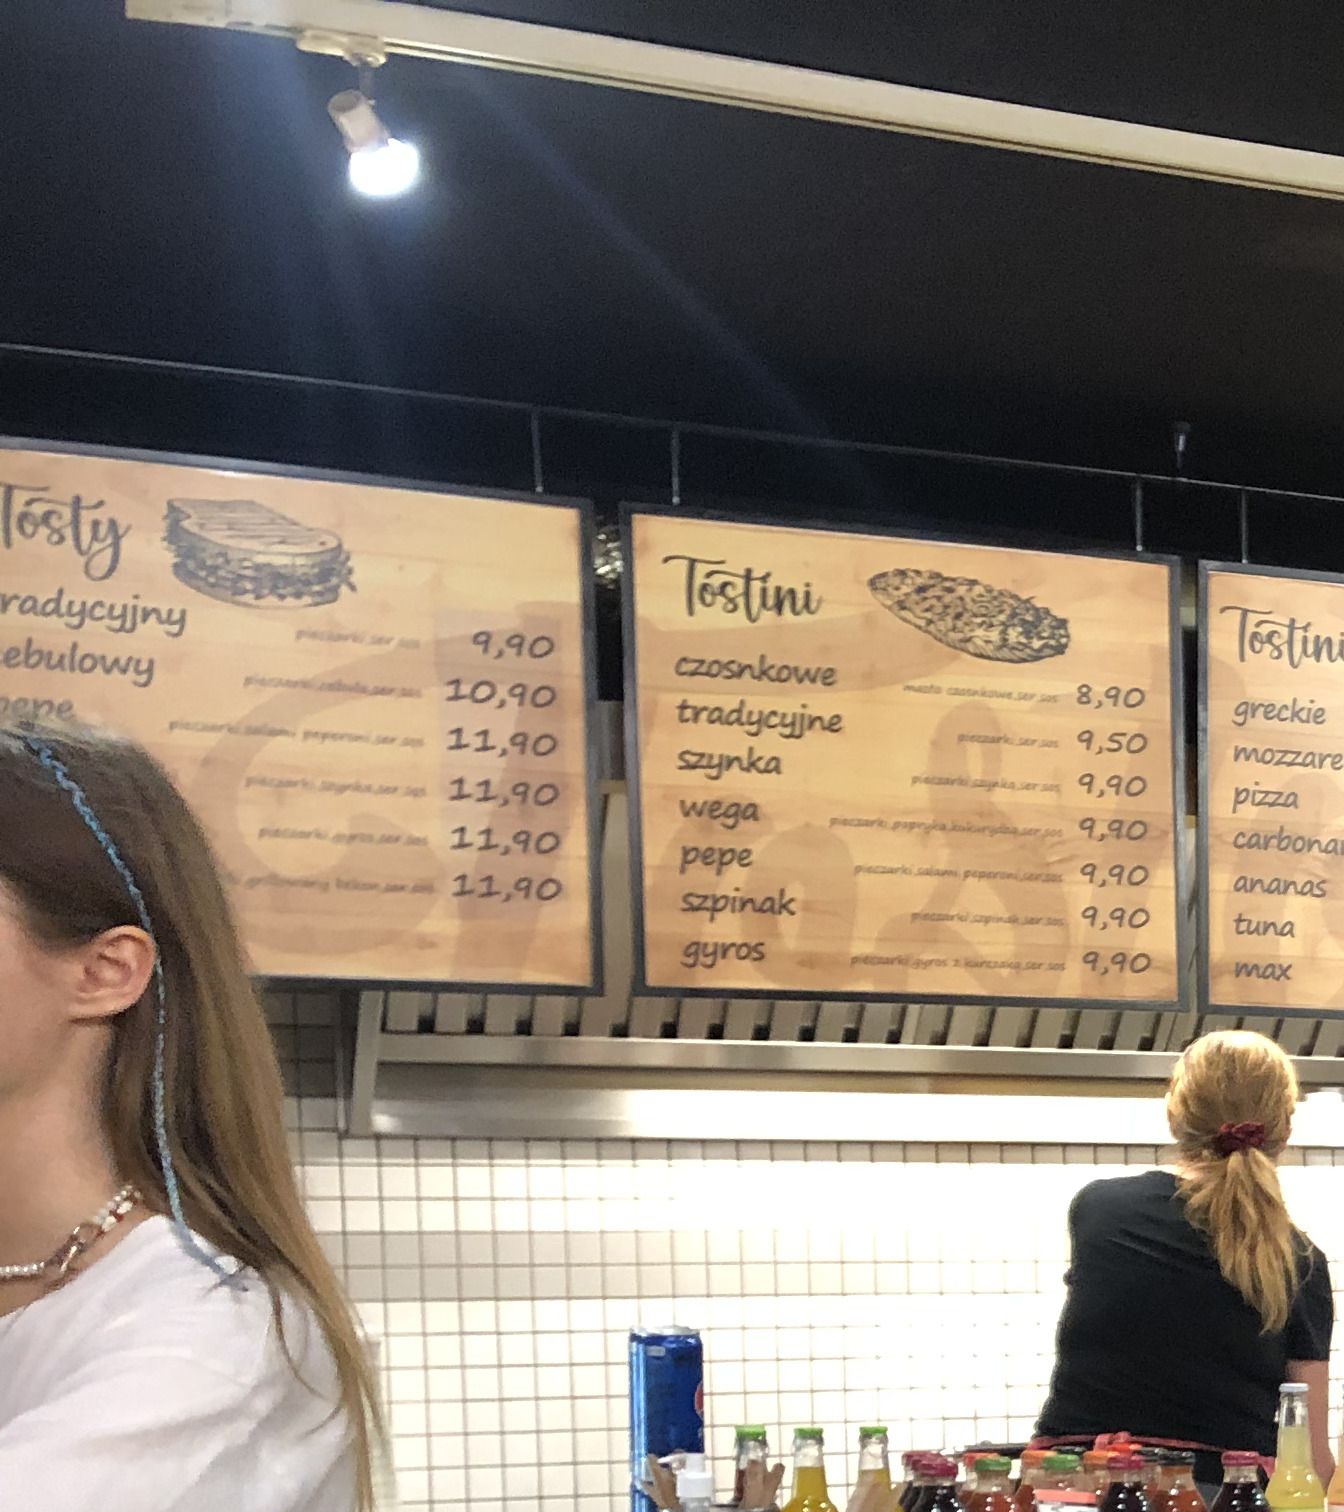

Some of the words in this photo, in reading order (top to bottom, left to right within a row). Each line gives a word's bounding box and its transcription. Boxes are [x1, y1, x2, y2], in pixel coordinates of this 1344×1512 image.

[0, 482, 132, 581] Tosty
[662, 555, 823, 623] Tostini
[471, 630, 555, 661] 9,90
[675, 653, 837, 686] czosnkowe
[445, 677, 556, 710] 10,90
[1076, 683, 1146, 710] 8,90
[676, 699, 843, 739] tradycyjne
[1233, 697, 1327, 727] greckie
[446, 726, 558, 760] 11,90
[1076, 729, 1148, 756] 9,50
[676, 747, 782, 780] szynka
[448, 776, 560, 808] 11,90
[1078, 772, 1148, 799] 9,90
[1233, 781, 1300, 814] pizza
[680, 798, 759, 829] wega
[450, 825, 561, 857] 11,90
[1079, 817, 1148, 844] 9,90
[680, 844, 753, 879] pepe
[1080, 862, 1150, 889] 9,90
[451, 873, 563, 903] 11,90
[1233, 874, 1328, 899] ananas
[681, 887, 797, 922] szpinak
[1081, 905, 1150, 932] 9,90
[1233, 913, 1296, 939] tuna
[682, 938, 765, 969] gyros
[1082, 950, 1151, 976] 9,90
[1234, 959, 1292, 981] max
